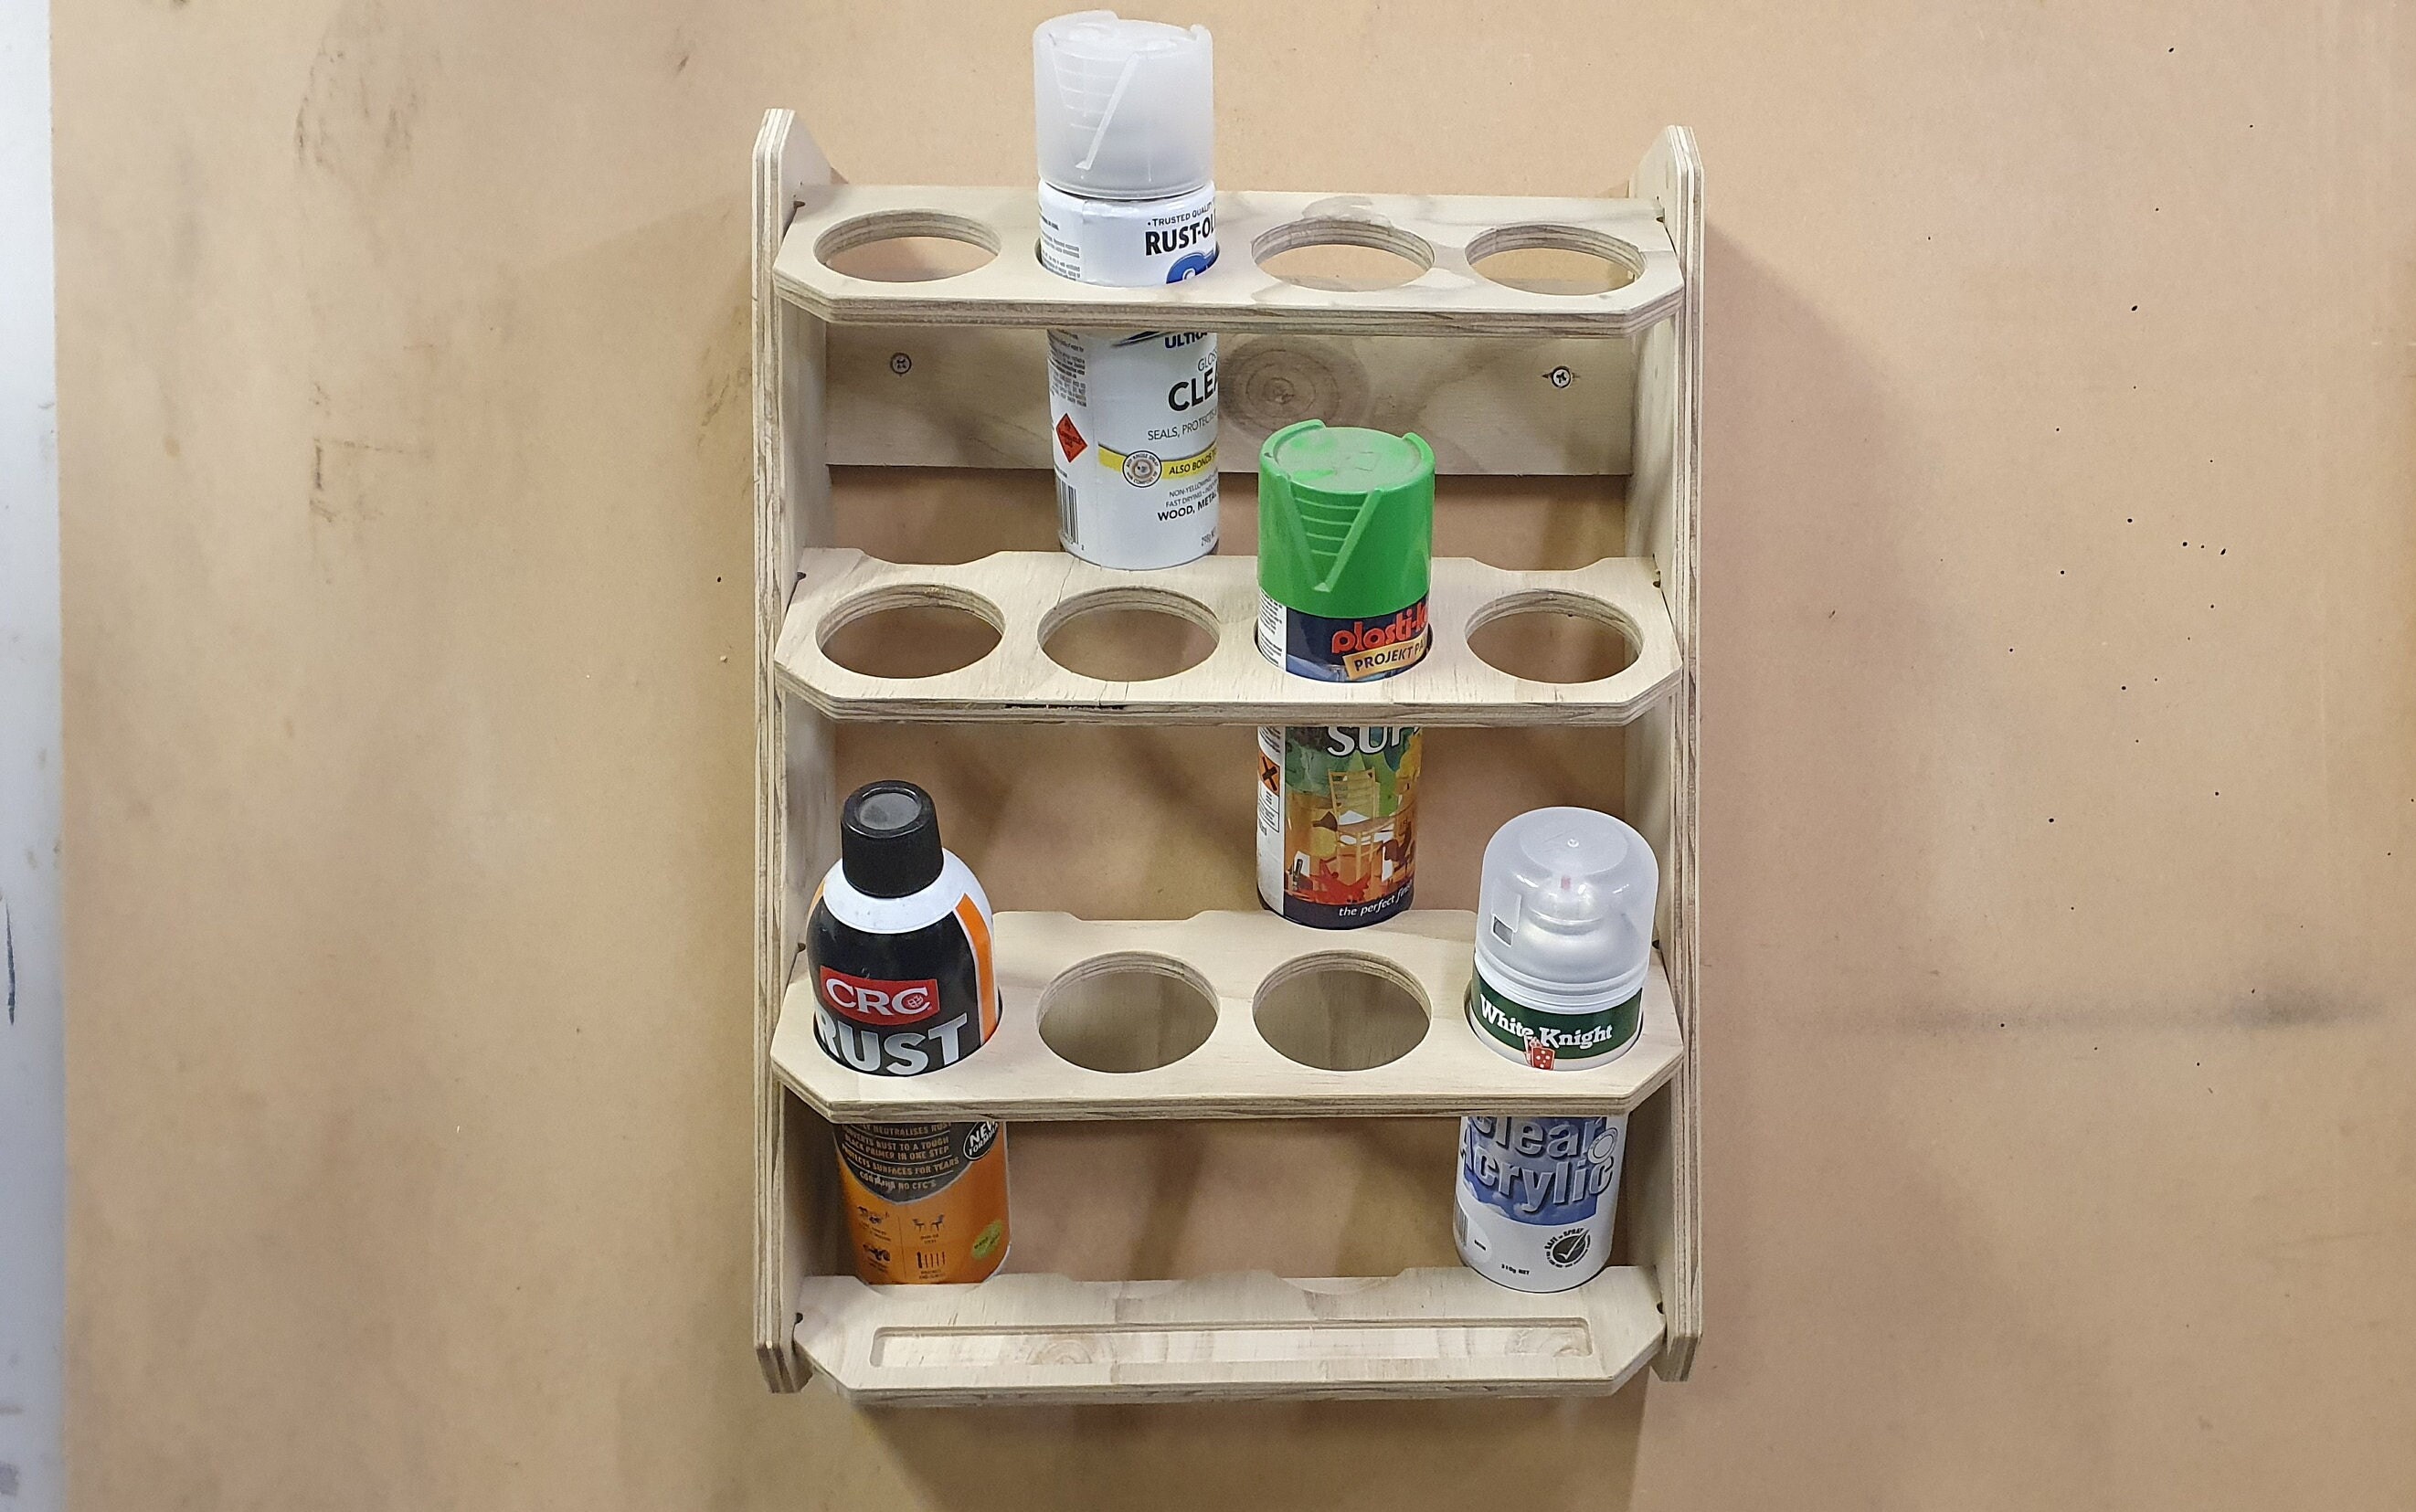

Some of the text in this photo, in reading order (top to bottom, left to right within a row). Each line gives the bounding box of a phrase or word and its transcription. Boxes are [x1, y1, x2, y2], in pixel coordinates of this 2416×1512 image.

[1152, 200, 1214, 227] TRUSTED QUALIT
[1198, 348, 1217, 372] GLOS
[1148, 427, 1181, 440] SEALS,
[1169, 463, 1191, 475] ALSO
[1157, 505, 1195, 522] WOOD,
[1165, 499, 1182, 508] FAST
[1331, 601, 1428, 654] plasti-k
[1354, 638, 1425, 671] PROJEKT PA
[1339, 906, 1358, 916] the
[1360, 894, 1395, 917] perfect
[825, 978, 930, 1016] CRC
[1479, 993, 1613, 1050] White Knight
[816, 1007, 968, 1075] RUST
[876, 1140, 896, 1151] RUST
[900, 1143, 910, 1151] TO
[913, 1143, 919, 1151] A
[921, 1136, 949, 1149] TOUGH
[897, 1152, 907, 1160] IN
[909, 1151, 927, 1160] ONE
[928, 1145, 949, 1158] STEP
[872, 1162, 913, 1176] SURFACES
[915, 1165, 931, 1175] FOR
[933, 1156, 959, 1172] YEARS
